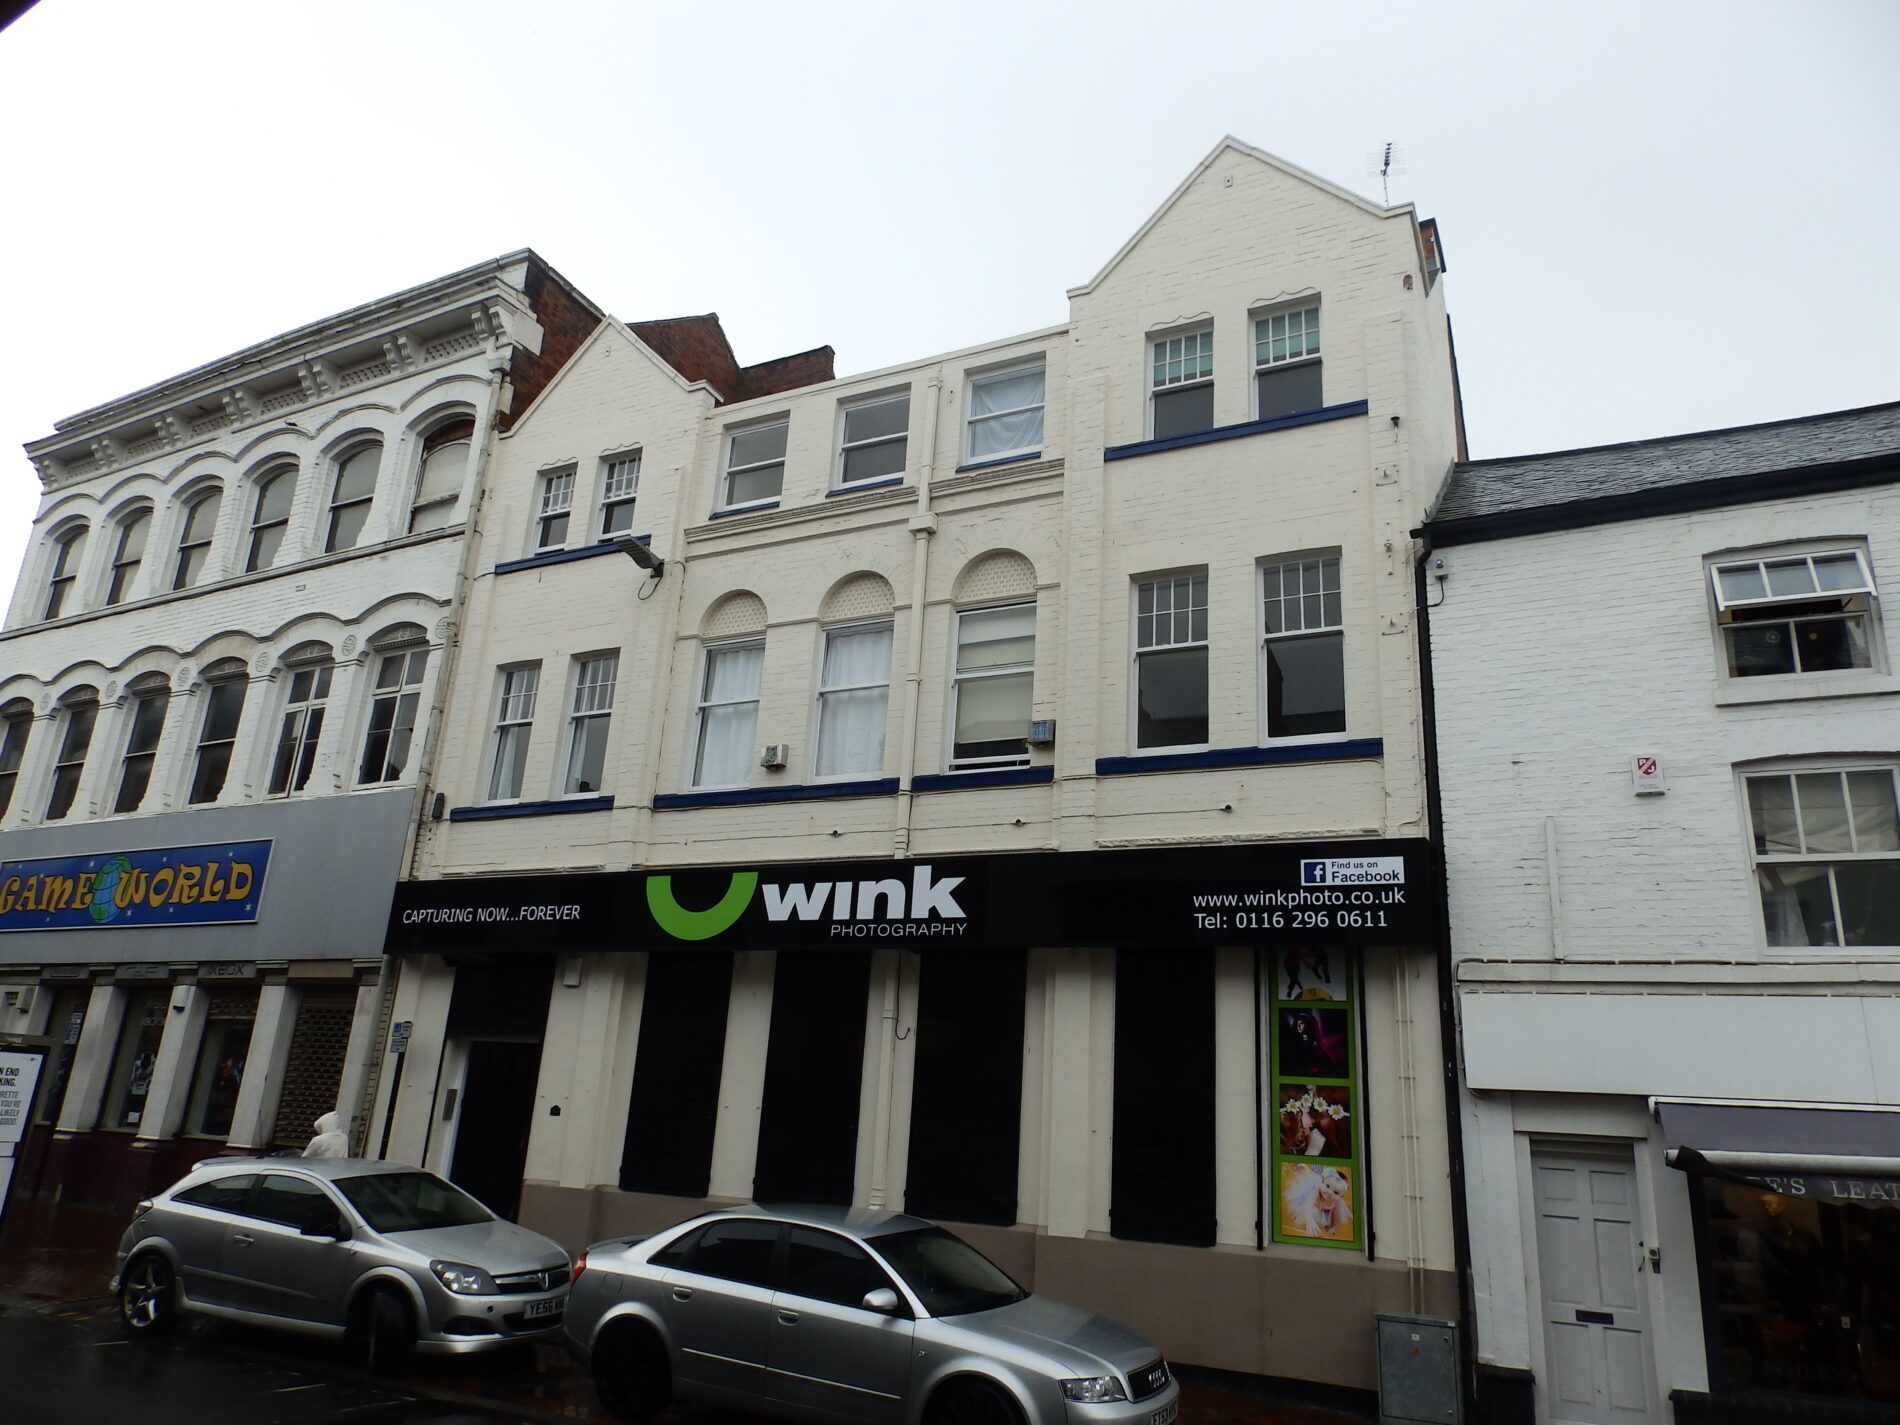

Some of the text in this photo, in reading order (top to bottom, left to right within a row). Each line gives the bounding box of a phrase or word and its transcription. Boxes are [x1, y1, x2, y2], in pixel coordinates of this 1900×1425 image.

[1331, 861, 1350, 869] Find
[1367, 861, 1378, 869] on
[1331, 870, 1400, 883] Facebook
[0, 860, 253, 915] GAME WORLD
[761, 865, 967, 921] wink
[1193, 887, 1406, 909] www.winkphoto.co.uk
[402, 908, 474, 924] CAPTURING
[1194, 910, 1388, 929] Tel: 0116 296 0611
[830, 922, 967, 938] PHOTOGRAPHY
